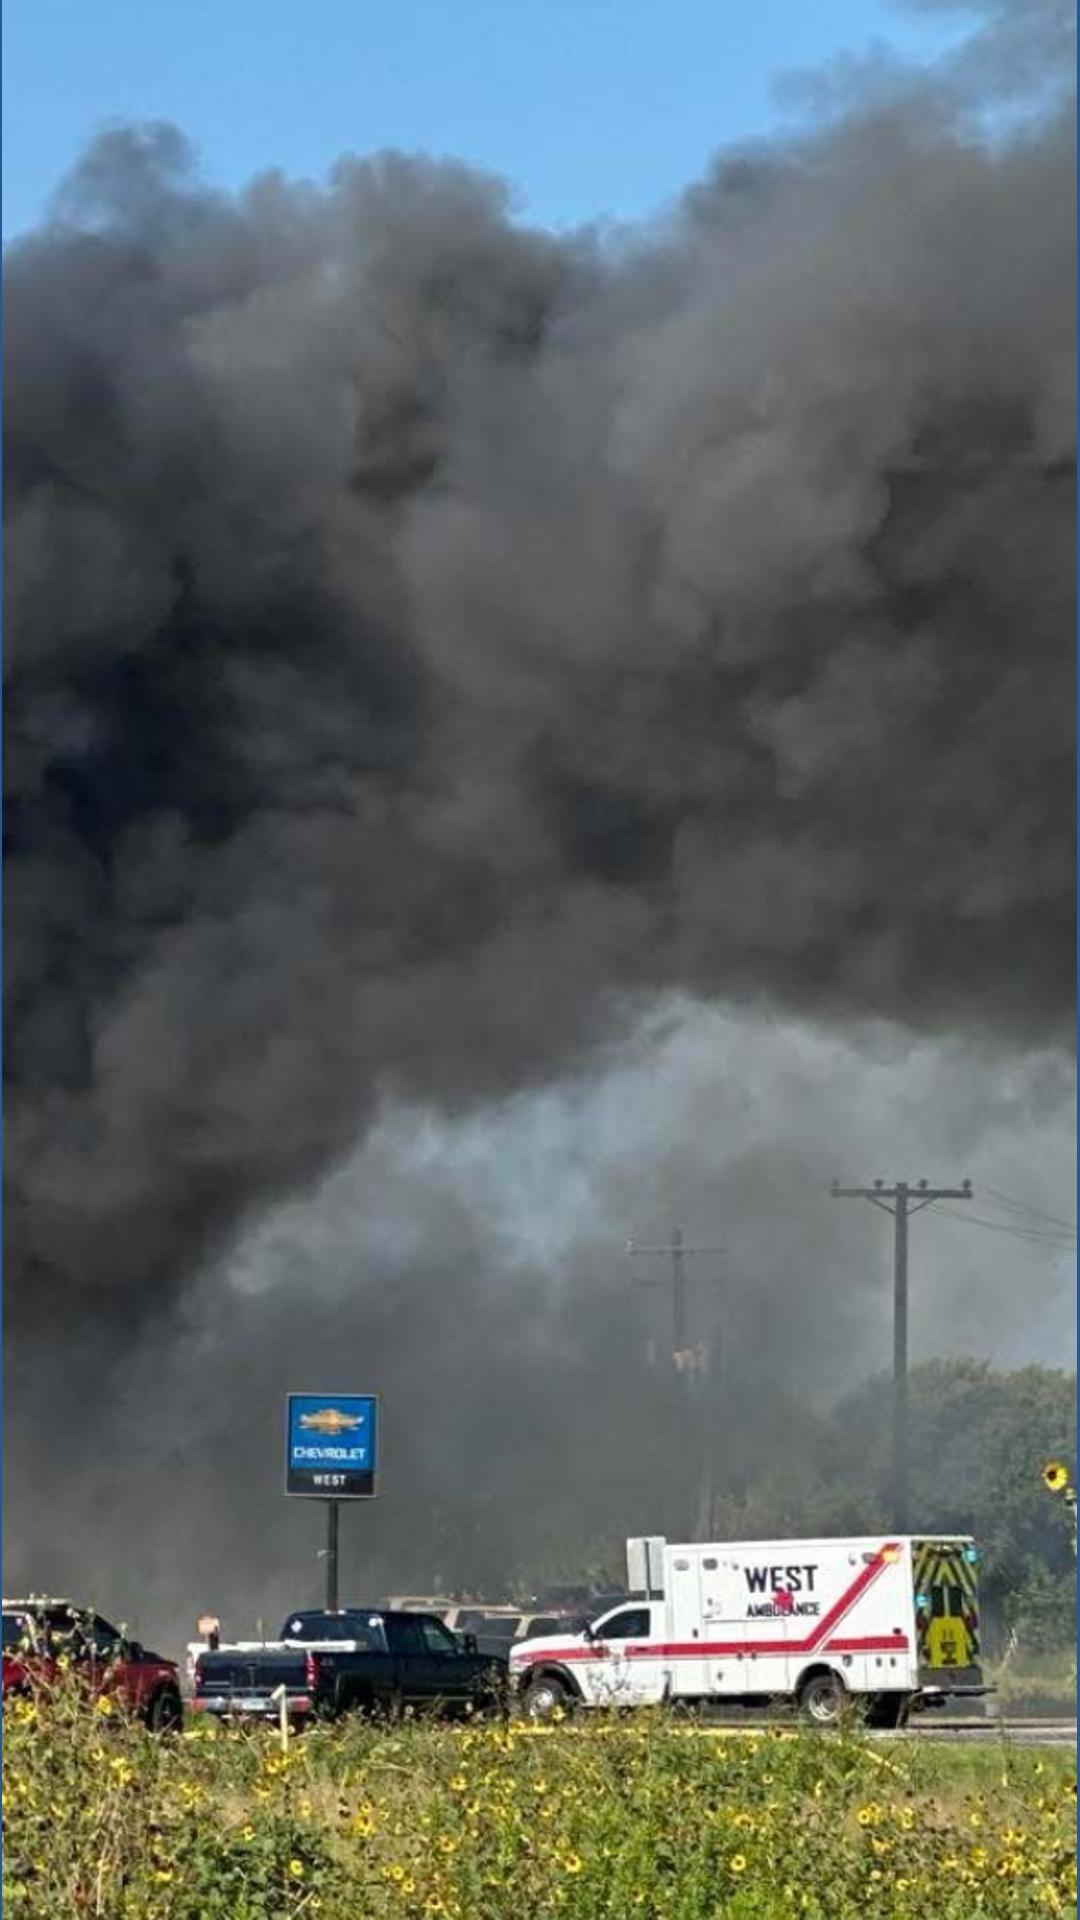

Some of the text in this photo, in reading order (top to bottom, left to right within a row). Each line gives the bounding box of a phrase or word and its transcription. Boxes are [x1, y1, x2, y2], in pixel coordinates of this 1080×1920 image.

[294, 1447, 366, 1459] CHEVROLET
[313, 1475, 346, 1486] WEST
[744, 1565, 818, 1593] WEST
